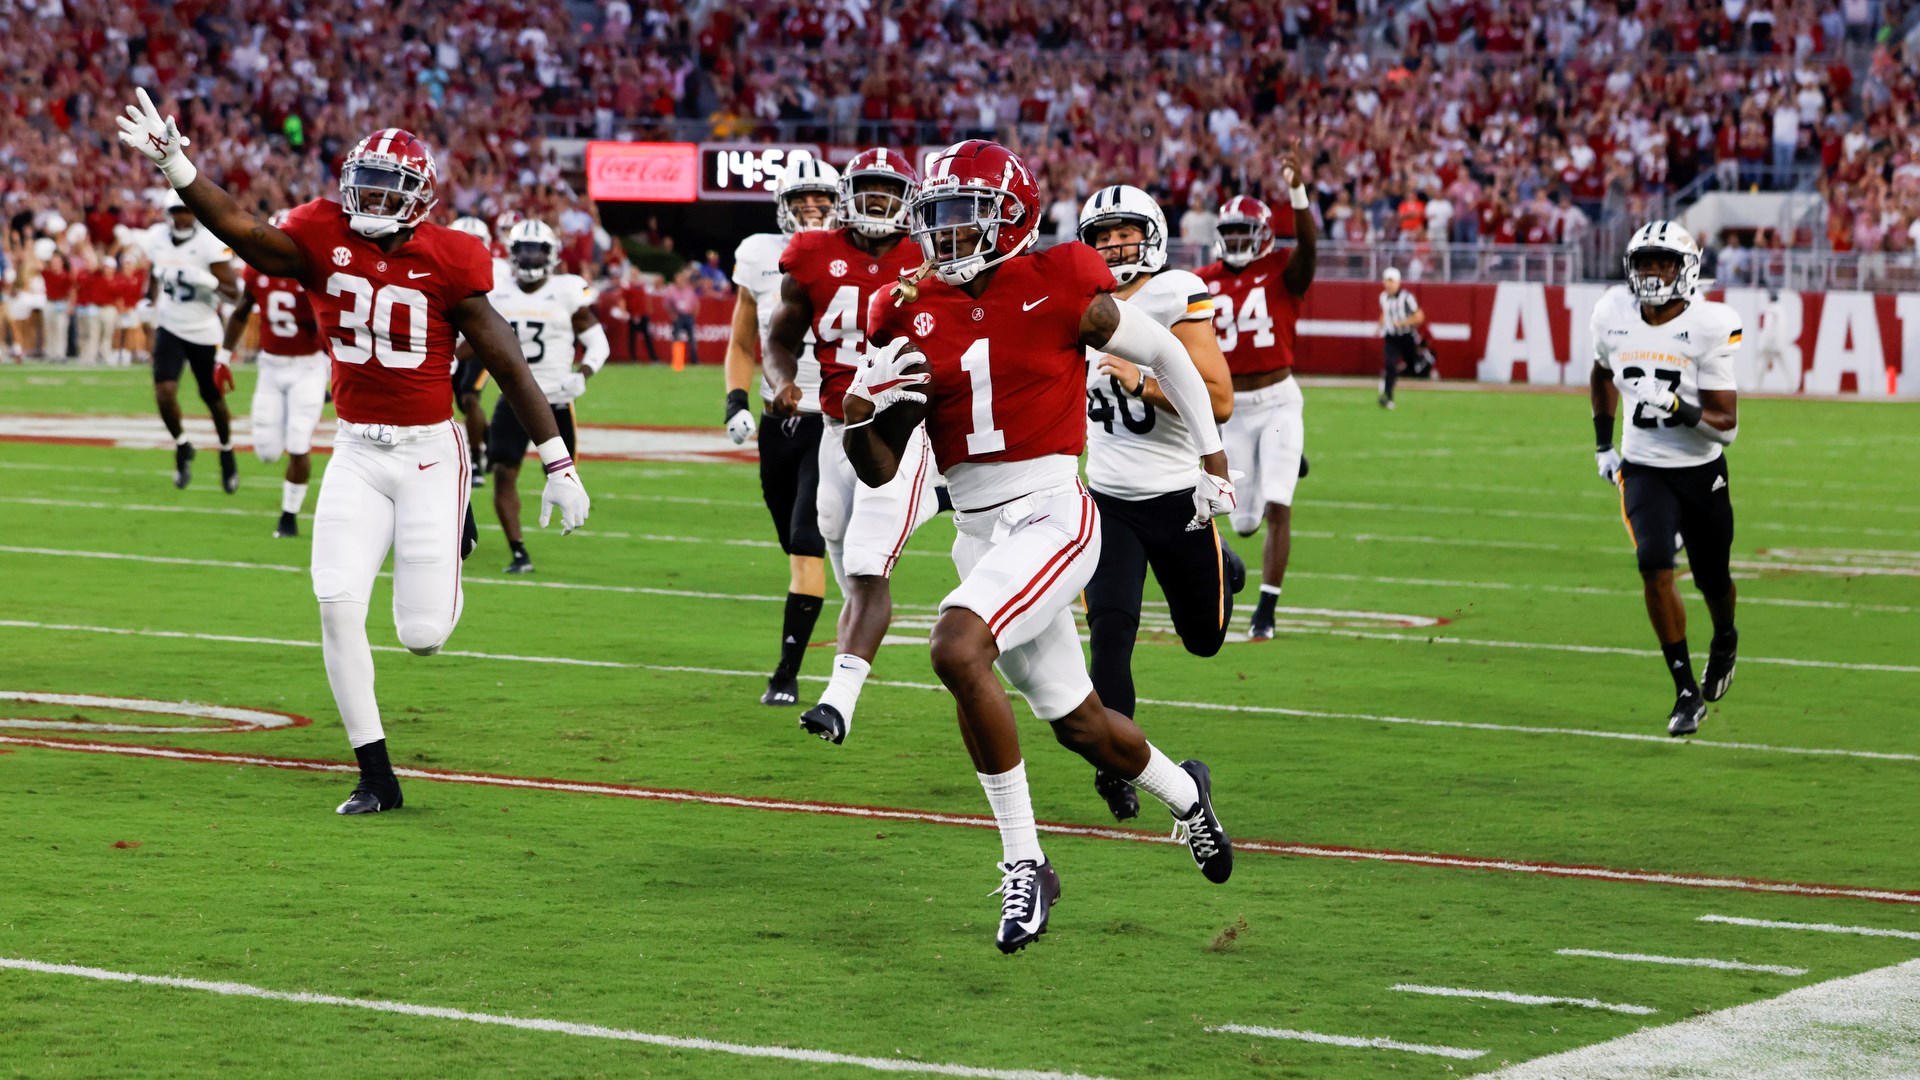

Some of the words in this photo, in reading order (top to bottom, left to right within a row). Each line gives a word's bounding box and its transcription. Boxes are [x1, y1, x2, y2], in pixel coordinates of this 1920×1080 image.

[331, 246, 352, 267] SEC
[829, 259, 848, 278] SEC
[267, 290, 299, 338] 6
[326, 271, 429, 369] 30
[819, 285, 880, 367] 4
[913, 311, 936, 338] SEC
[1213, 286, 1276, 353] 34
[1476, 280, 1920, 397] ABA
[1619, 351, 1664, 362] SOUTHERN
[1666, 354, 1691, 369] MISS
[960, 337, 1006, 456] 1
[1086, 360, 1156, 435] 40
